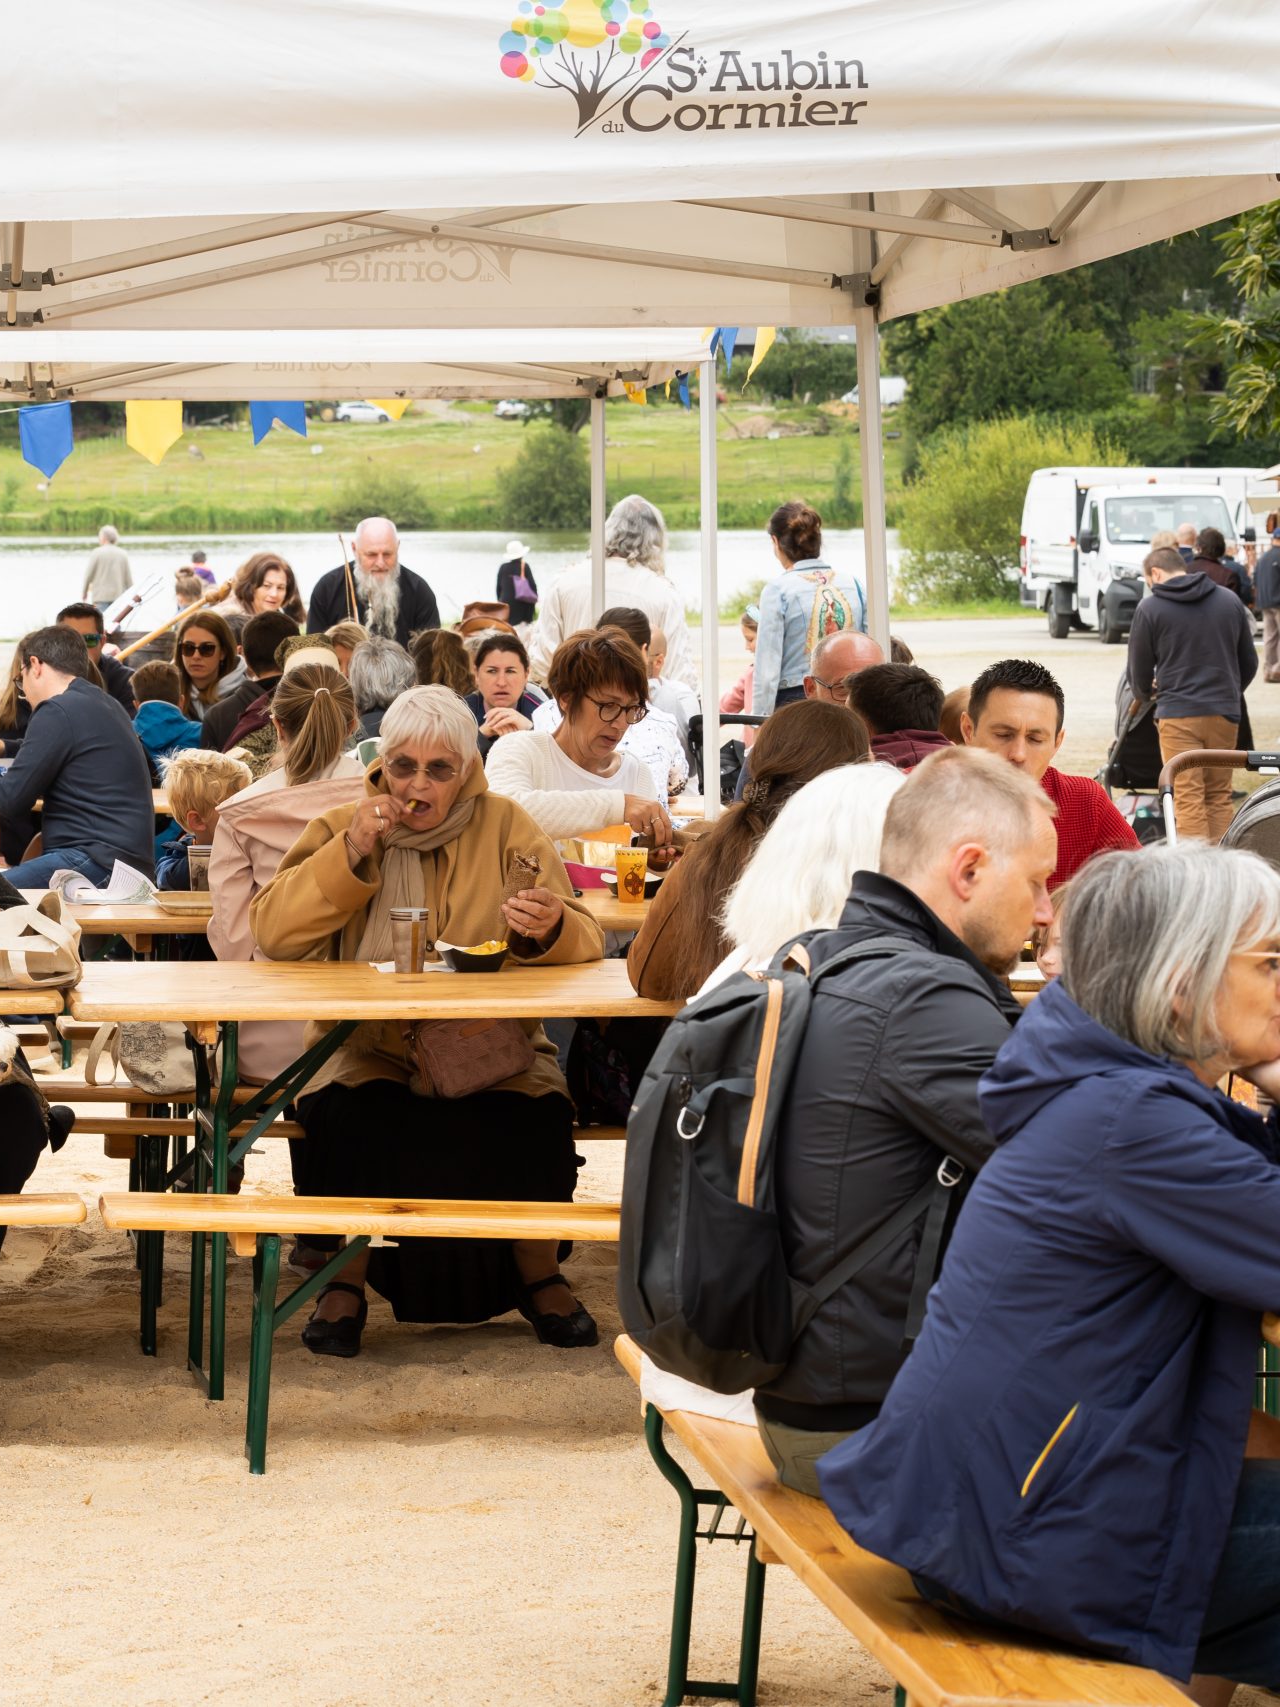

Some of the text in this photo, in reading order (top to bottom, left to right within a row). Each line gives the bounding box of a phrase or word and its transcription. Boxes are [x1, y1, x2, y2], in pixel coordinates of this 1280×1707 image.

[709, 50, 869, 92] Aubin
[601, 84, 868, 134] du Cormier
